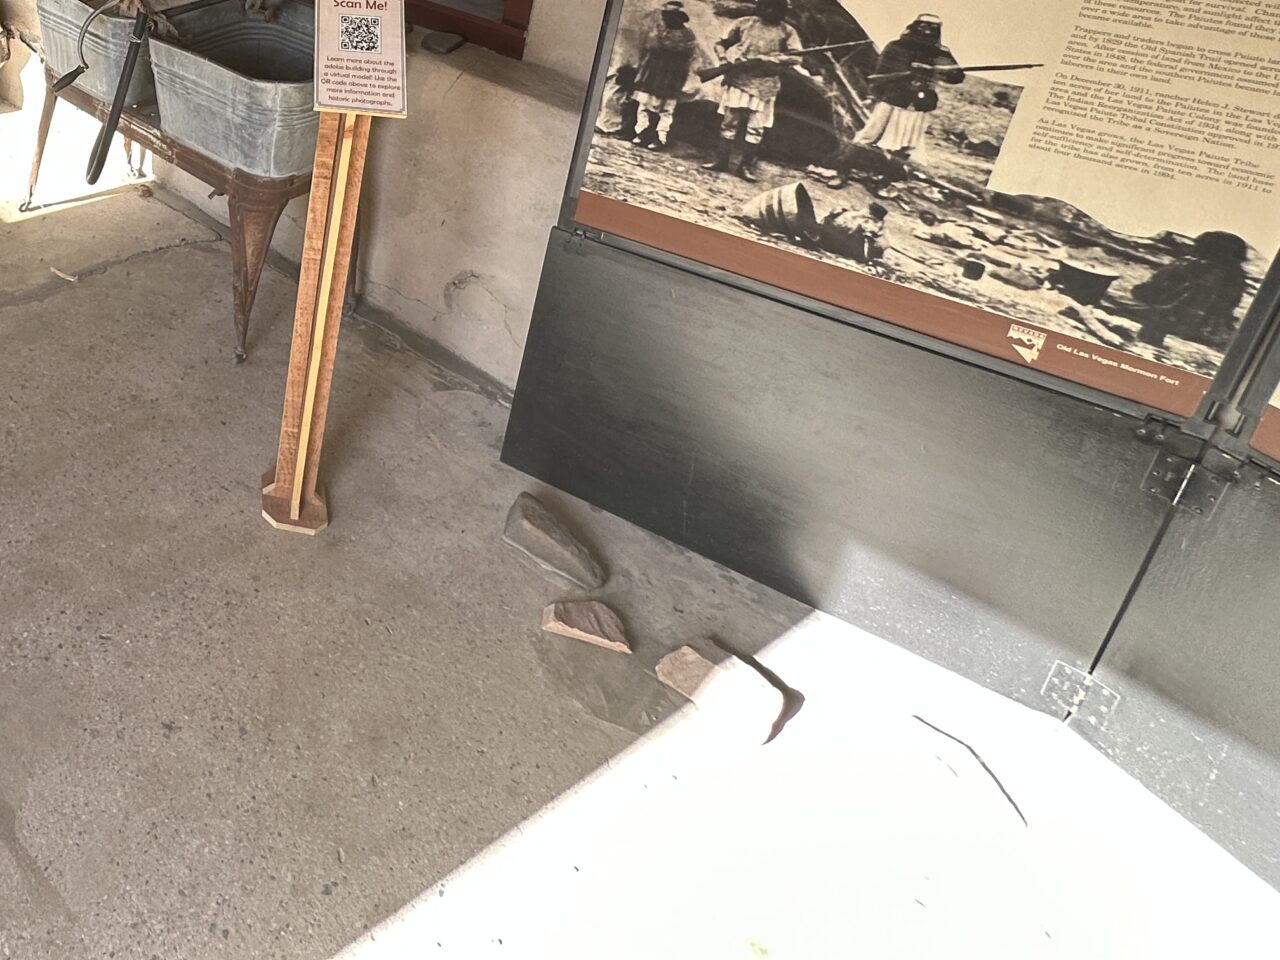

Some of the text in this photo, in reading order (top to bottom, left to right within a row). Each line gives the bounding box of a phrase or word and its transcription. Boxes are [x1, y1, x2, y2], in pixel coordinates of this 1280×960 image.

[366, 0, 387, 10] Me!
[344, 88, 380, 96] information
[1056, 343, 1180, 386] Old Las Vegas Mormon Fort
